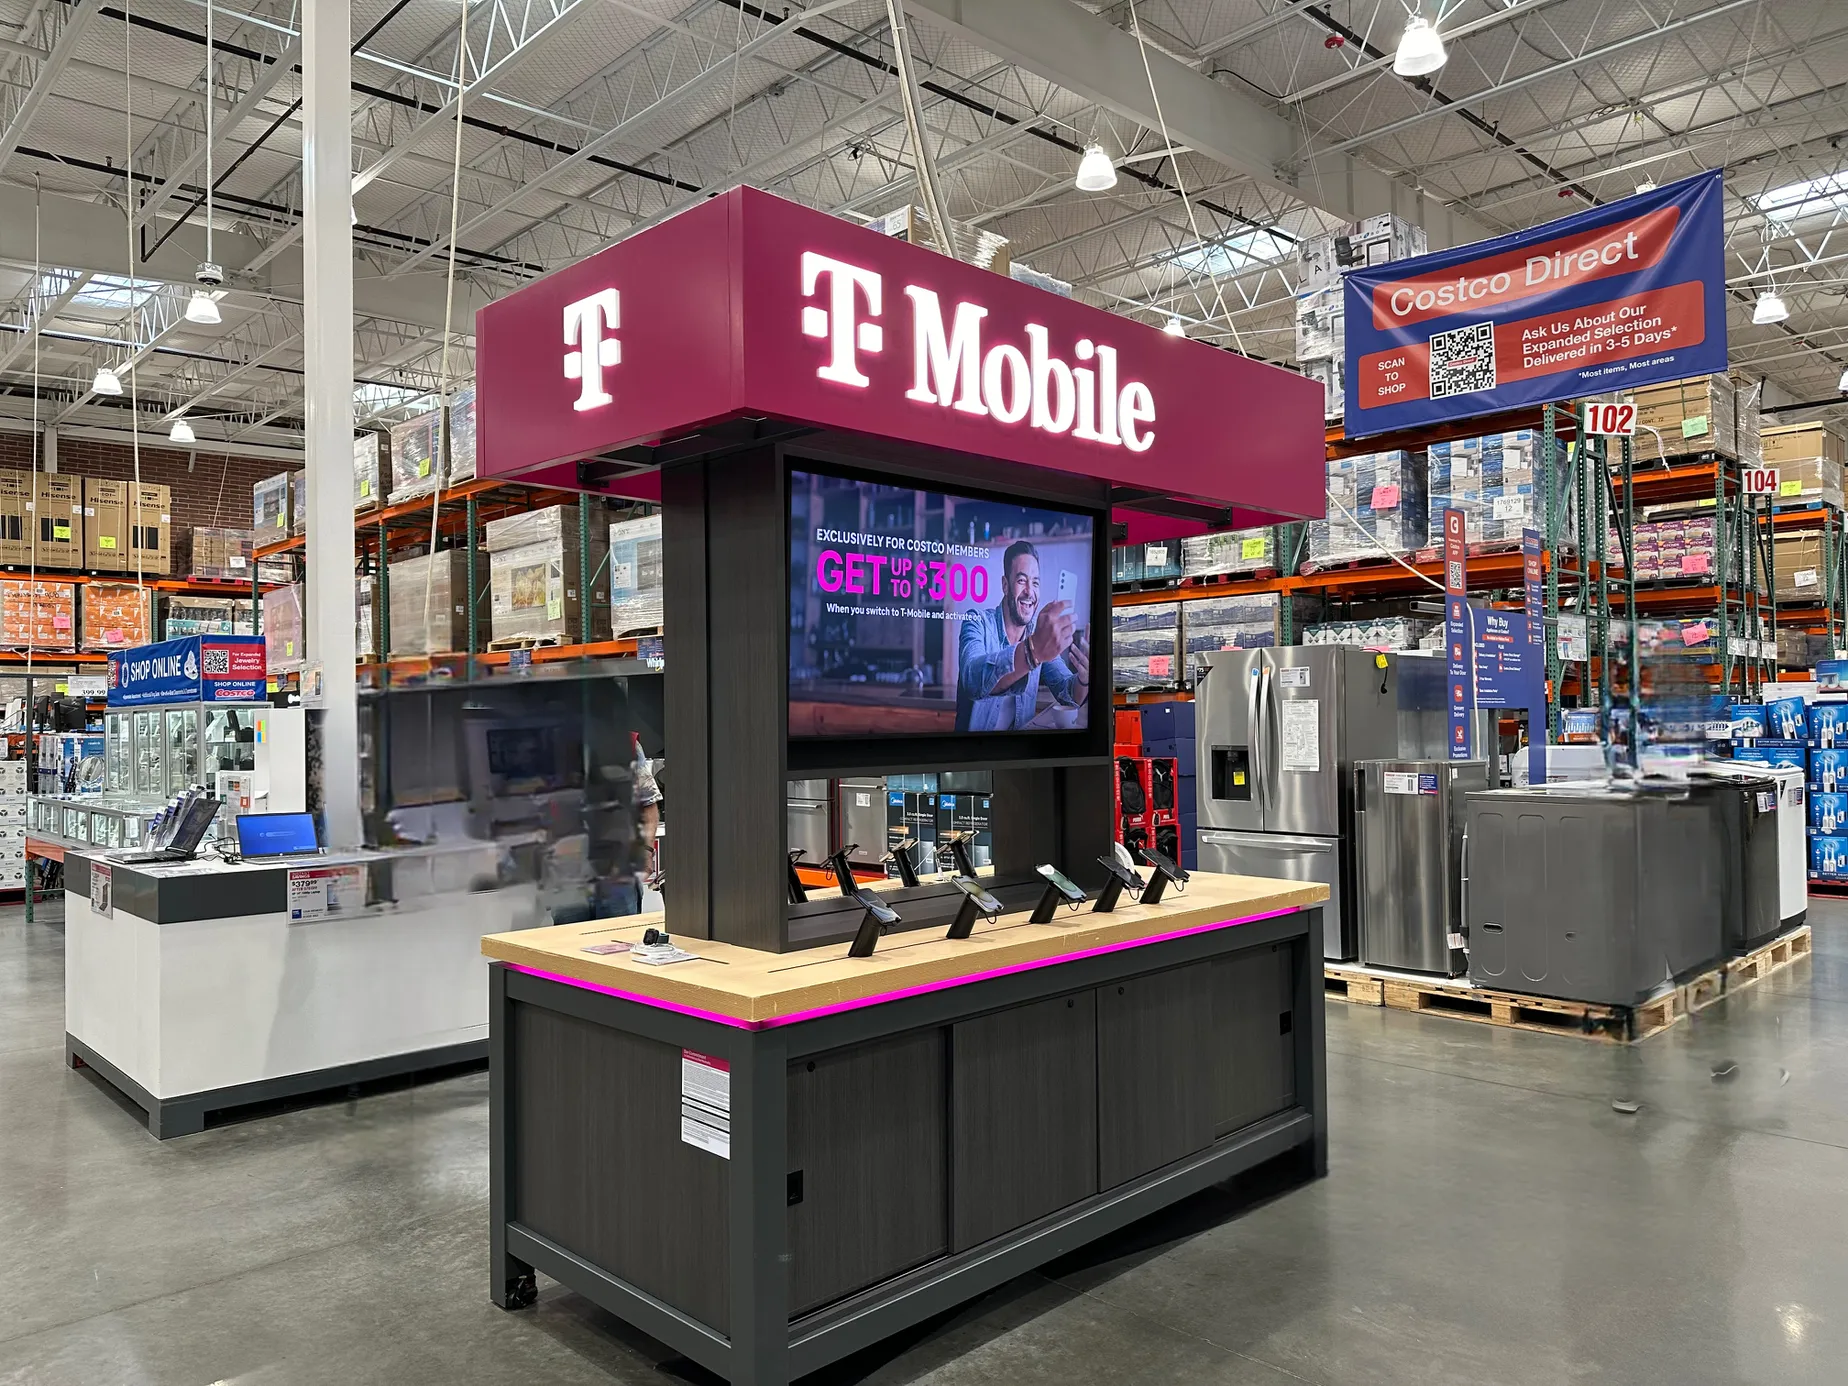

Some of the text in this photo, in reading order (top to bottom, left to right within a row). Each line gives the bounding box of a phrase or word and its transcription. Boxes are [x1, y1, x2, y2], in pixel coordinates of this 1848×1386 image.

[1390, 231, 1639, 317] Costco Direct
[1521, 304, 1647, 341] Ask Us About Our
[1522, 317, 1662, 355] Expanded Selection
[563, 287, 622, 412] T
[1523, 345, 1587, 369] Delivered
[1590, 341, 1602, 353] in
[1606, 337, 1630, 351] 3-5
[904, 284, 1156, 452] Mobile
[1378, 358, 1405, 371] SCAN
[1603, 365, 1628, 375] items,
[1629, 360, 1651, 370] Most
[1652, 355, 1675, 366] areas
[1385, 372, 1399, 383] TO
[1378, 383, 1406, 396] SHOP
[1588, 405, 1634, 434] 102
[1744, 469, 1777, 492] 104
[41, 491, 76, 500] Hisense
[90, 496, 124, 505] Hisense
[816, 528, 990, 559] EXCLUSIVELY FOR COSTCO MEMBERS
[816, 549, 888, 595] GET
[891, 557, 912, 577] UP
[891, 579, 912, 599] TO
[915, 559, 989, 603] $300
[826, 603, 850, 614] When
[850, 607, 865, 616] you
[865, 606, 890, 617] switch
[891, 607, 900, 617] to
[900, 607, 931, 619] T-Mobile
[931, 610, 945, 620] and
[945, 611, 972, 621] activate
[1487, 616, 1508, 628] Why Buy
[130, 660, 151, 682] SHOP
[151, 655, 182, 679] ONLINE
[215, 688, 256, 698] COSTCO
